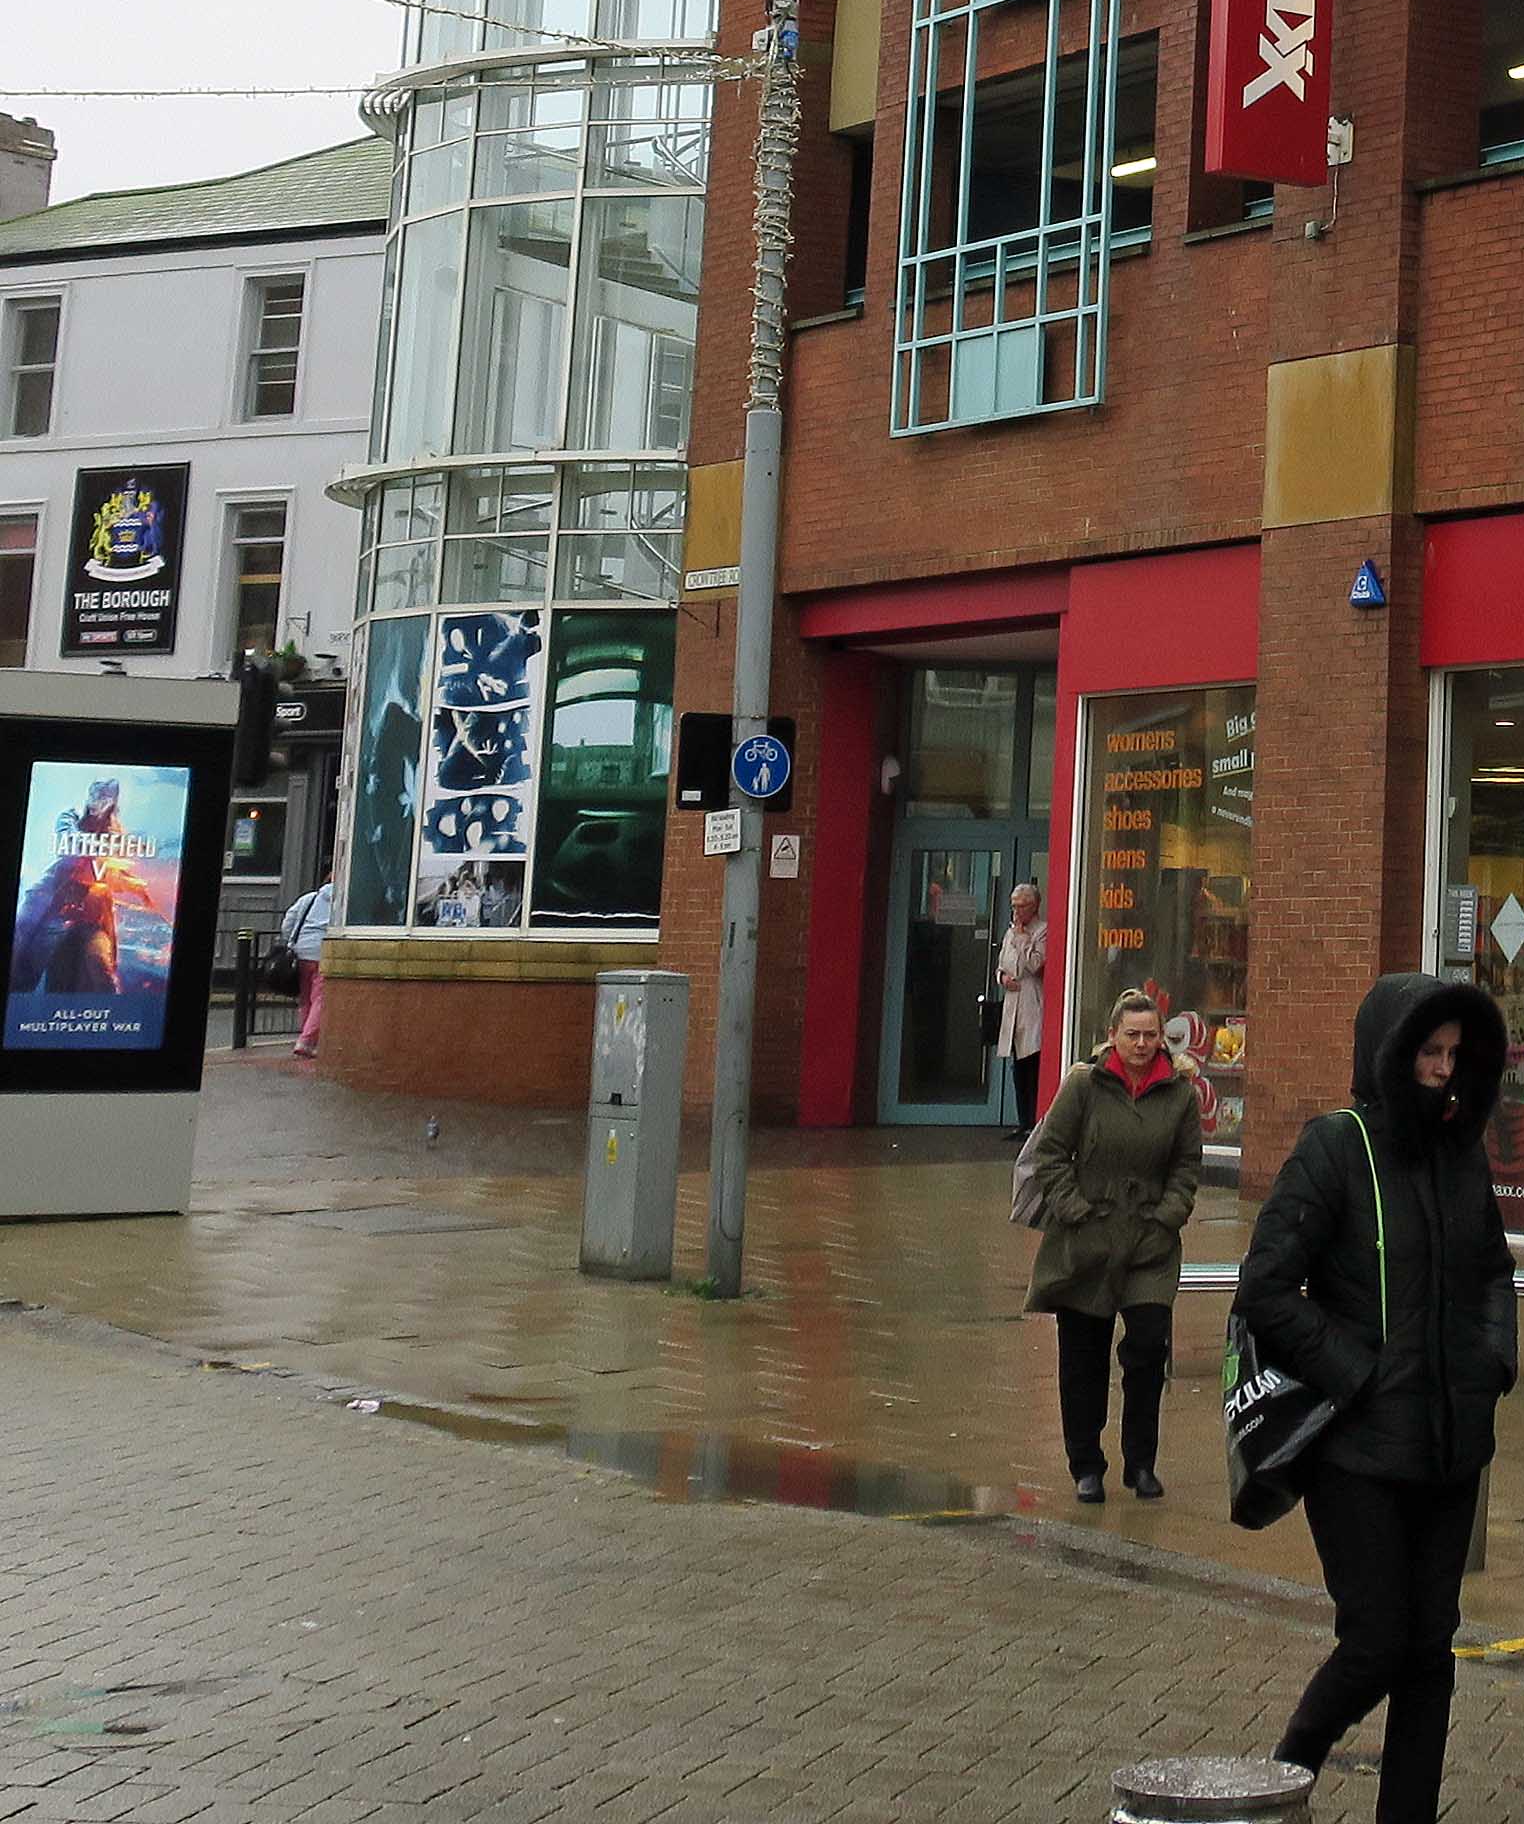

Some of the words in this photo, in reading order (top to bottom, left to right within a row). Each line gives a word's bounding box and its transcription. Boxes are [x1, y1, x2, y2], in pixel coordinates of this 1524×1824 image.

[74, 592, 100, 609] THE
[102, 589, 170, 609] BOROUGH
[276, 707, 301, 717] Sport
[1226, 716, 1248, 737] Big
[1107, 730, 1175, 752] womens
[1212, 749, 1248, 773] small
[1104, 768, 1202, 792] accessories
[1104, 805, 1151, 831] shoes
[91, 859, 107, 880] V
[1103, 850, 1145, 869] mens
[1100, 884, 1133, 909] kids
[1099, 924, 1144, 949] home
[53, 1009, 111, 1020] ALL-OUT
[20, 1023, 107, 1033] MULTIPLAYER
[112, 1023, 141, 1032] WAR
